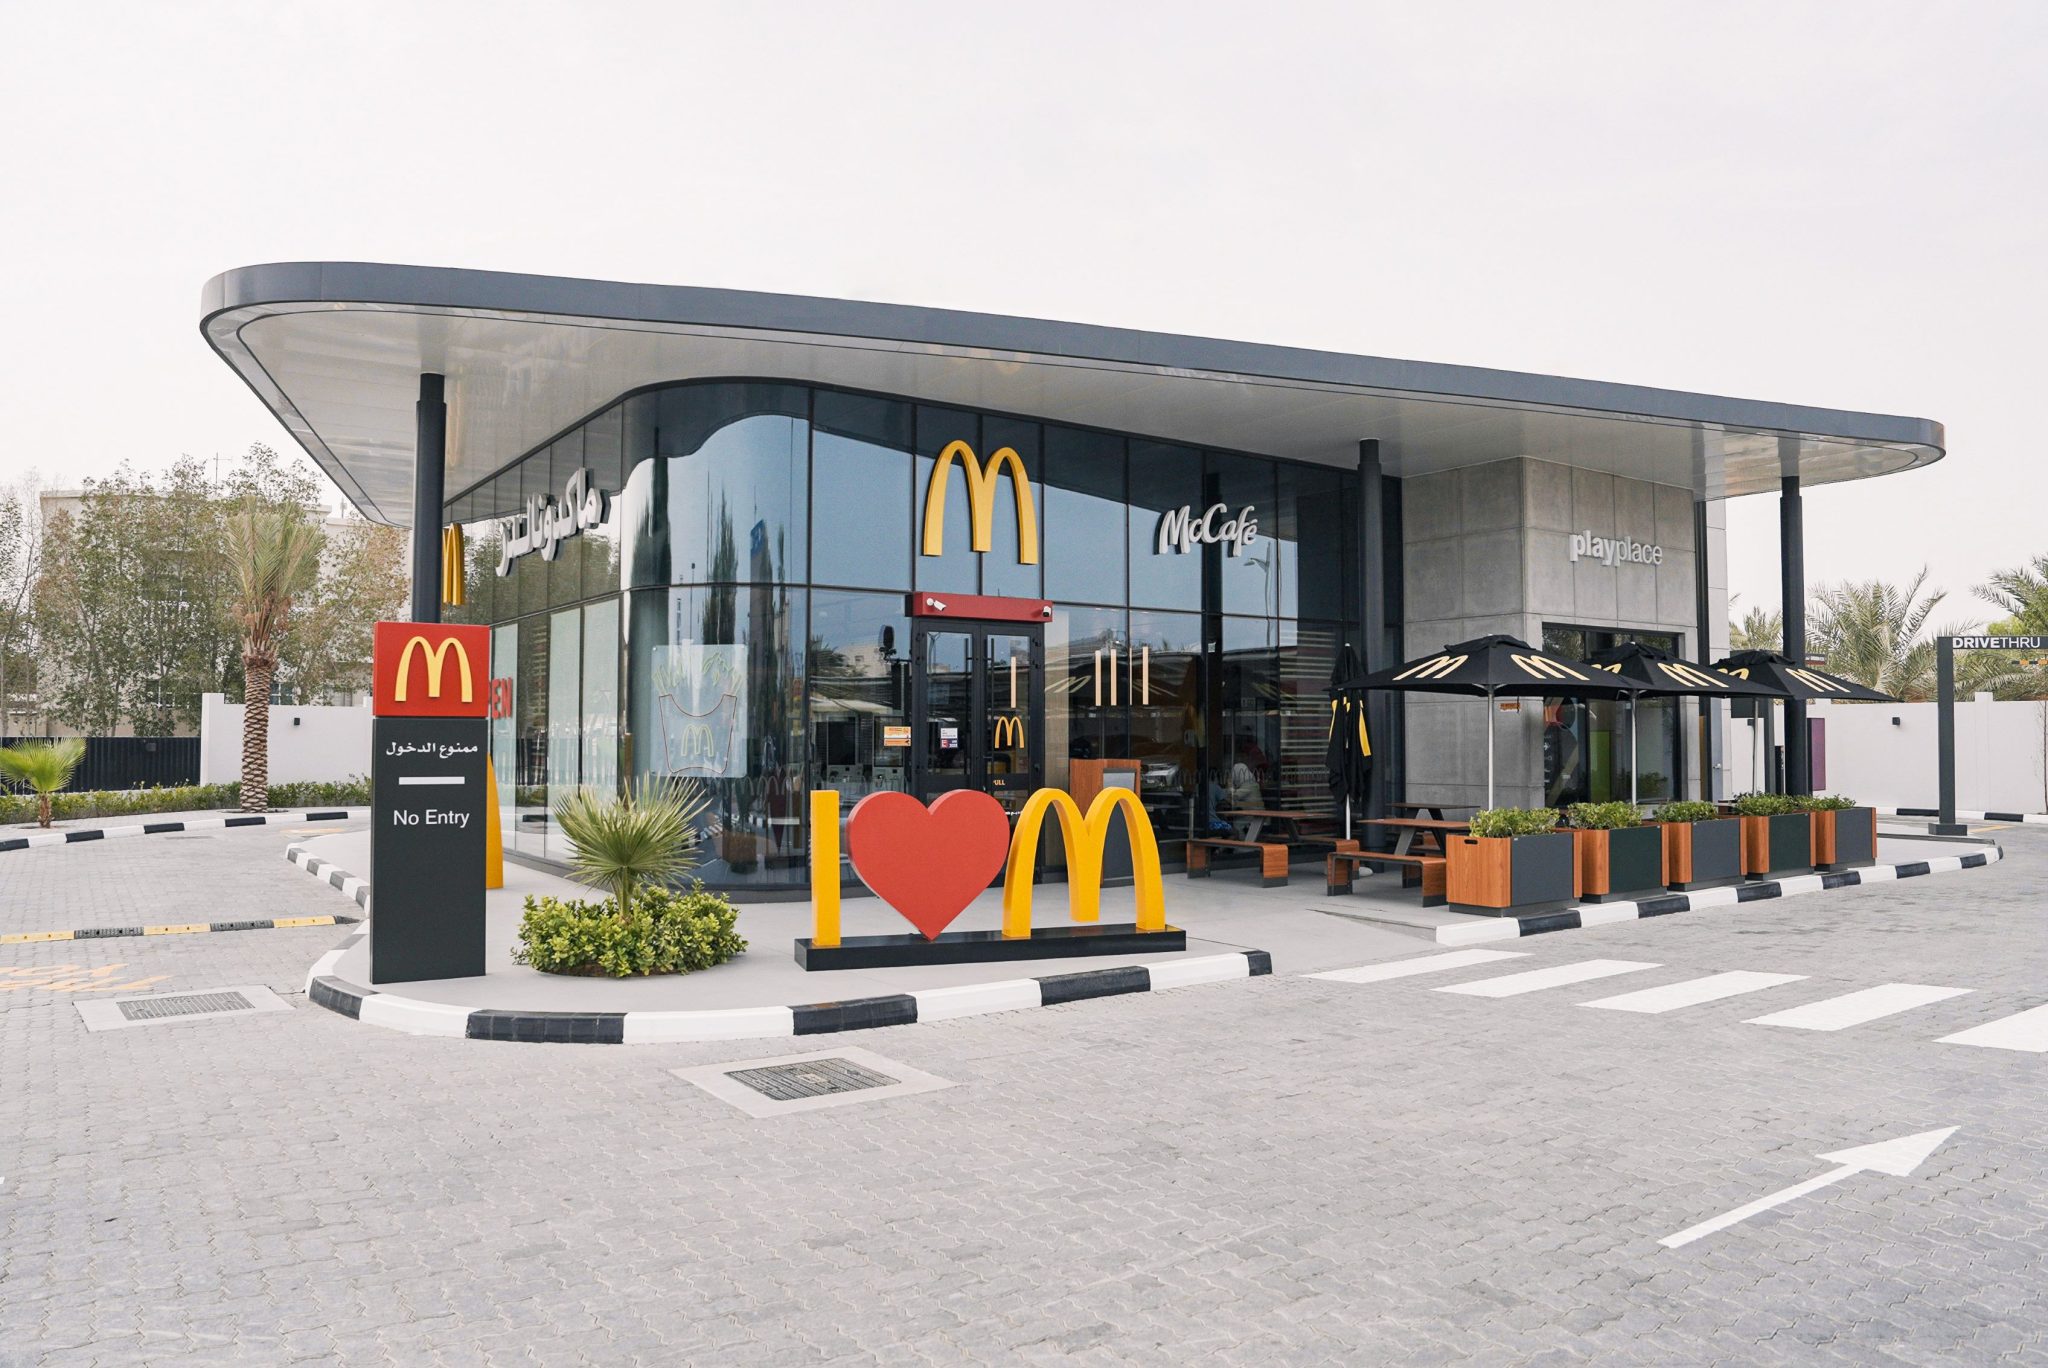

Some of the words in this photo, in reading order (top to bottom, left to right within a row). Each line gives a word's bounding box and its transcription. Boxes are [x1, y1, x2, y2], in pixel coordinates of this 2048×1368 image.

[1158, 502, 1258, 557] McCafé
[1569, 530, 1663, 567] playplace
[1953, 636, 2041, 649] DRIVETHRU
[488, 677, 513, 720] EN
[386, 741, 436, 757] الدخول
[439, 742, 479, 759] ممنوع
[393, 810, 420, 826] No
[425, 809, 470, 828] Entry
